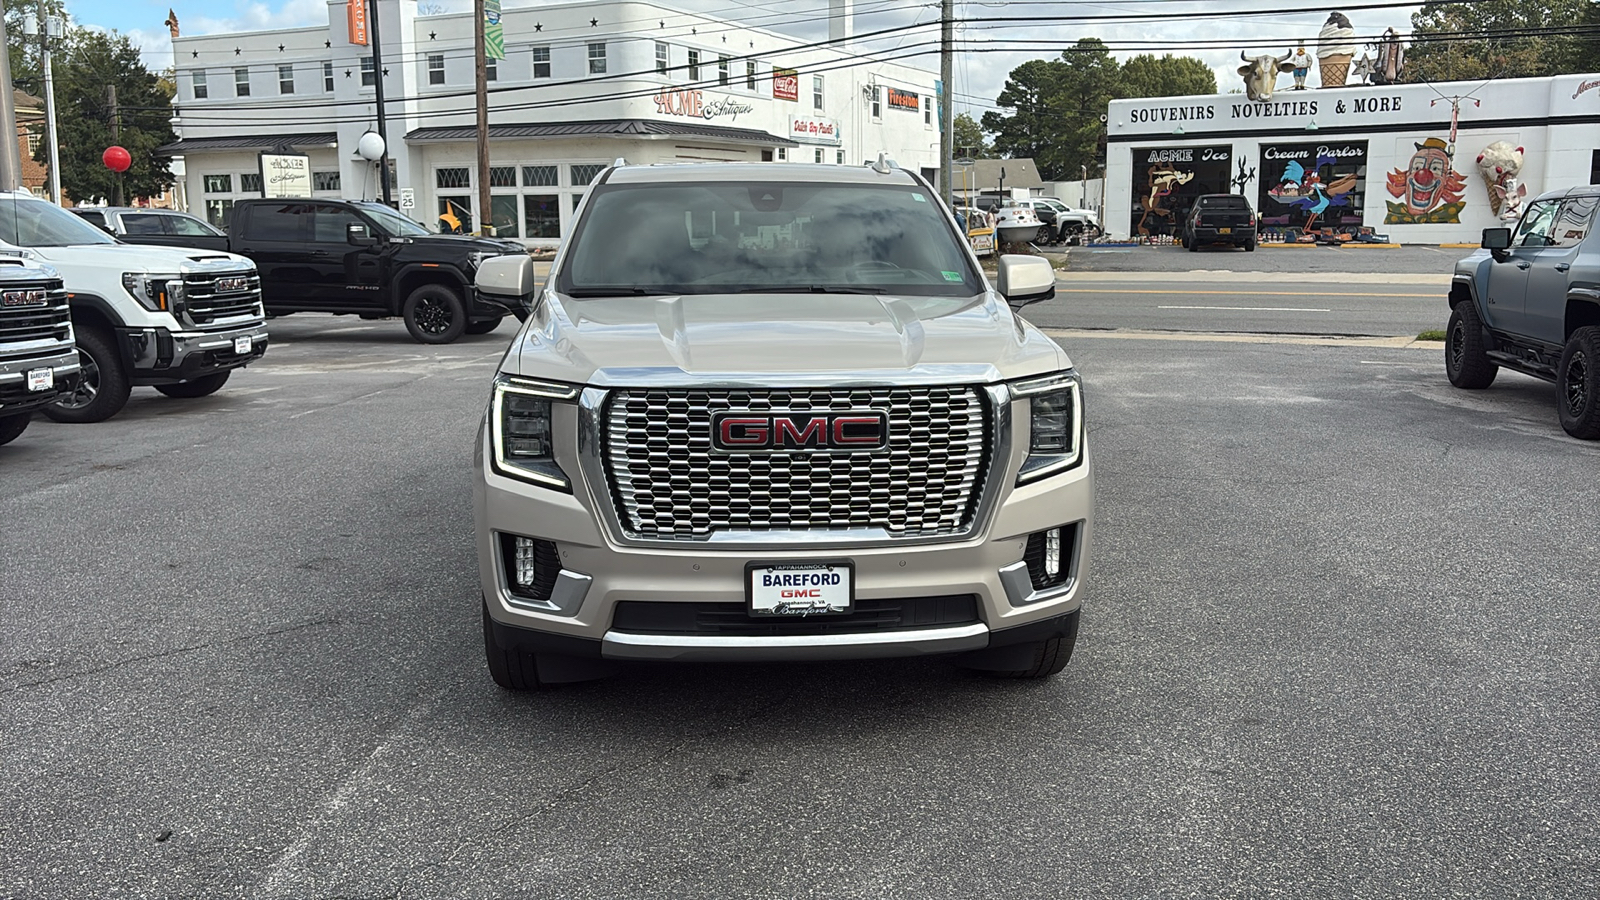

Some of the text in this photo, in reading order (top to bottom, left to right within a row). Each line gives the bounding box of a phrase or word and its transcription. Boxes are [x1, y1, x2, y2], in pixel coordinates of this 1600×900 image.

[653, 86, 703, 118] ACME
[888, 88, 919, 107] Firestone
[1130, 97, 1402, 123] SOUVENIRS NOVELTIES & MORE
[794, 120, 833, 136] Dutch Boy Paints
[1147, 148, 1229, 163] ACME Ice
[1265, 145, 1365, 160] Cream Parlor
[402, 199, 414, 207] 25
[3, 290, 47, 305] GMC
[720, 417, 881, 446] GMC
[762, 573, 841, 587] BAREFORD
[780, 589, 821, 598] GMC
[771, 603, 832, 618] Bareford
